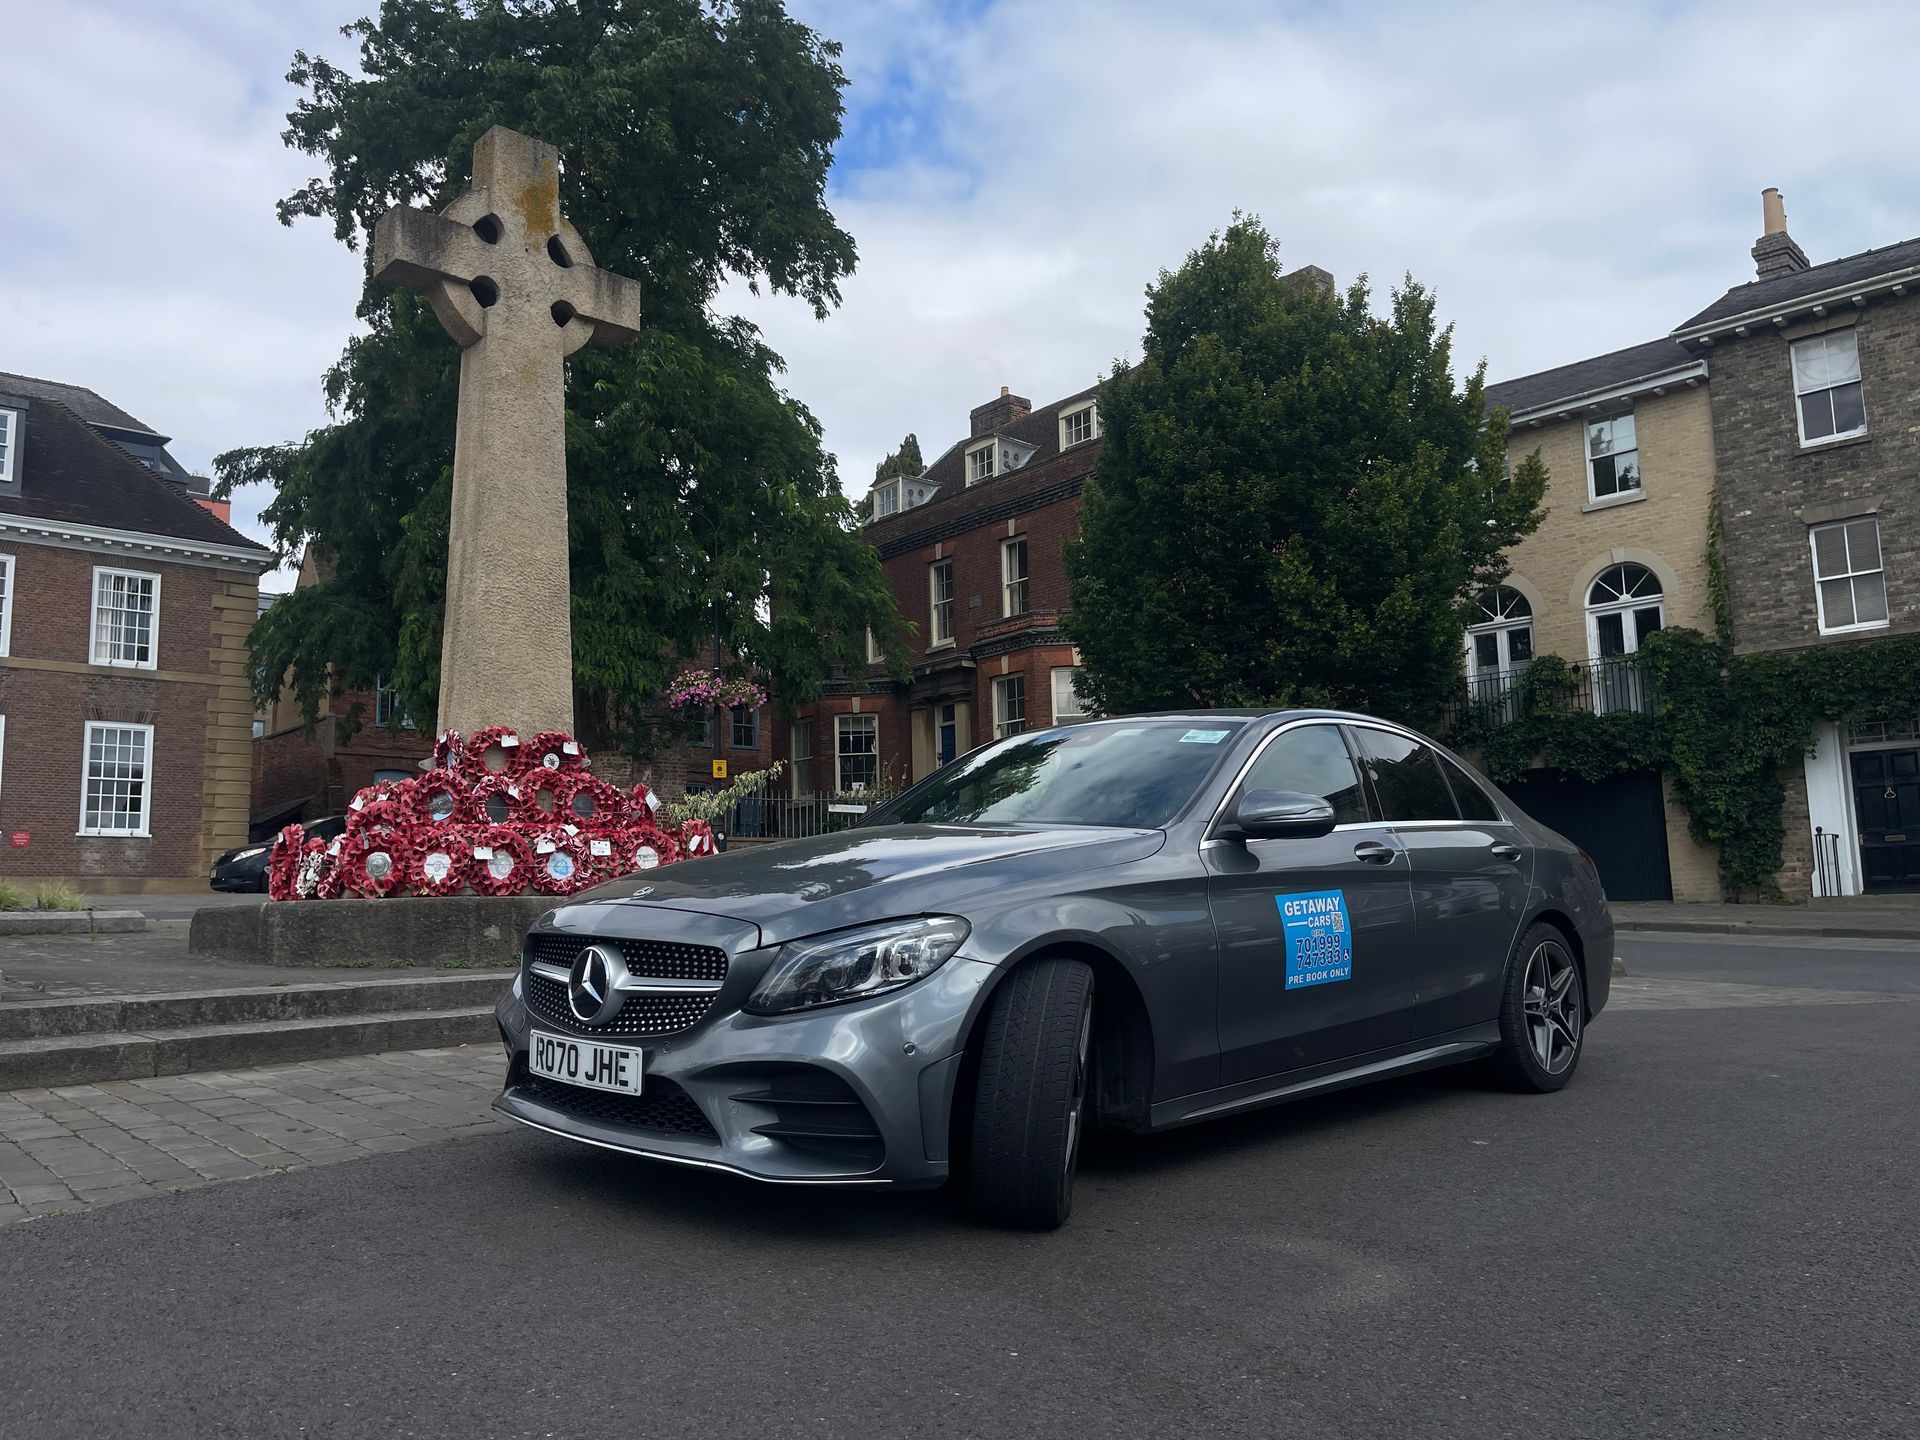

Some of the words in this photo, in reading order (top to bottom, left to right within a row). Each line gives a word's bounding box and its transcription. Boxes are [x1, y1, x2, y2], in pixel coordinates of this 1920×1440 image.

[1284, 896, 1340, 917] GETAWAY
[1307, 915, 1331, 928] CARS
[1296, 933, 1341, 954] 701999
[1296, 948, 1341, 970] 747333
[1288, 974, 1304, 985] PRE
[1306, 970, 1328, 982] BOOK
[1330, 967, 1350, 978] ONLY
[584, 1047, 630, 1087] JHE
